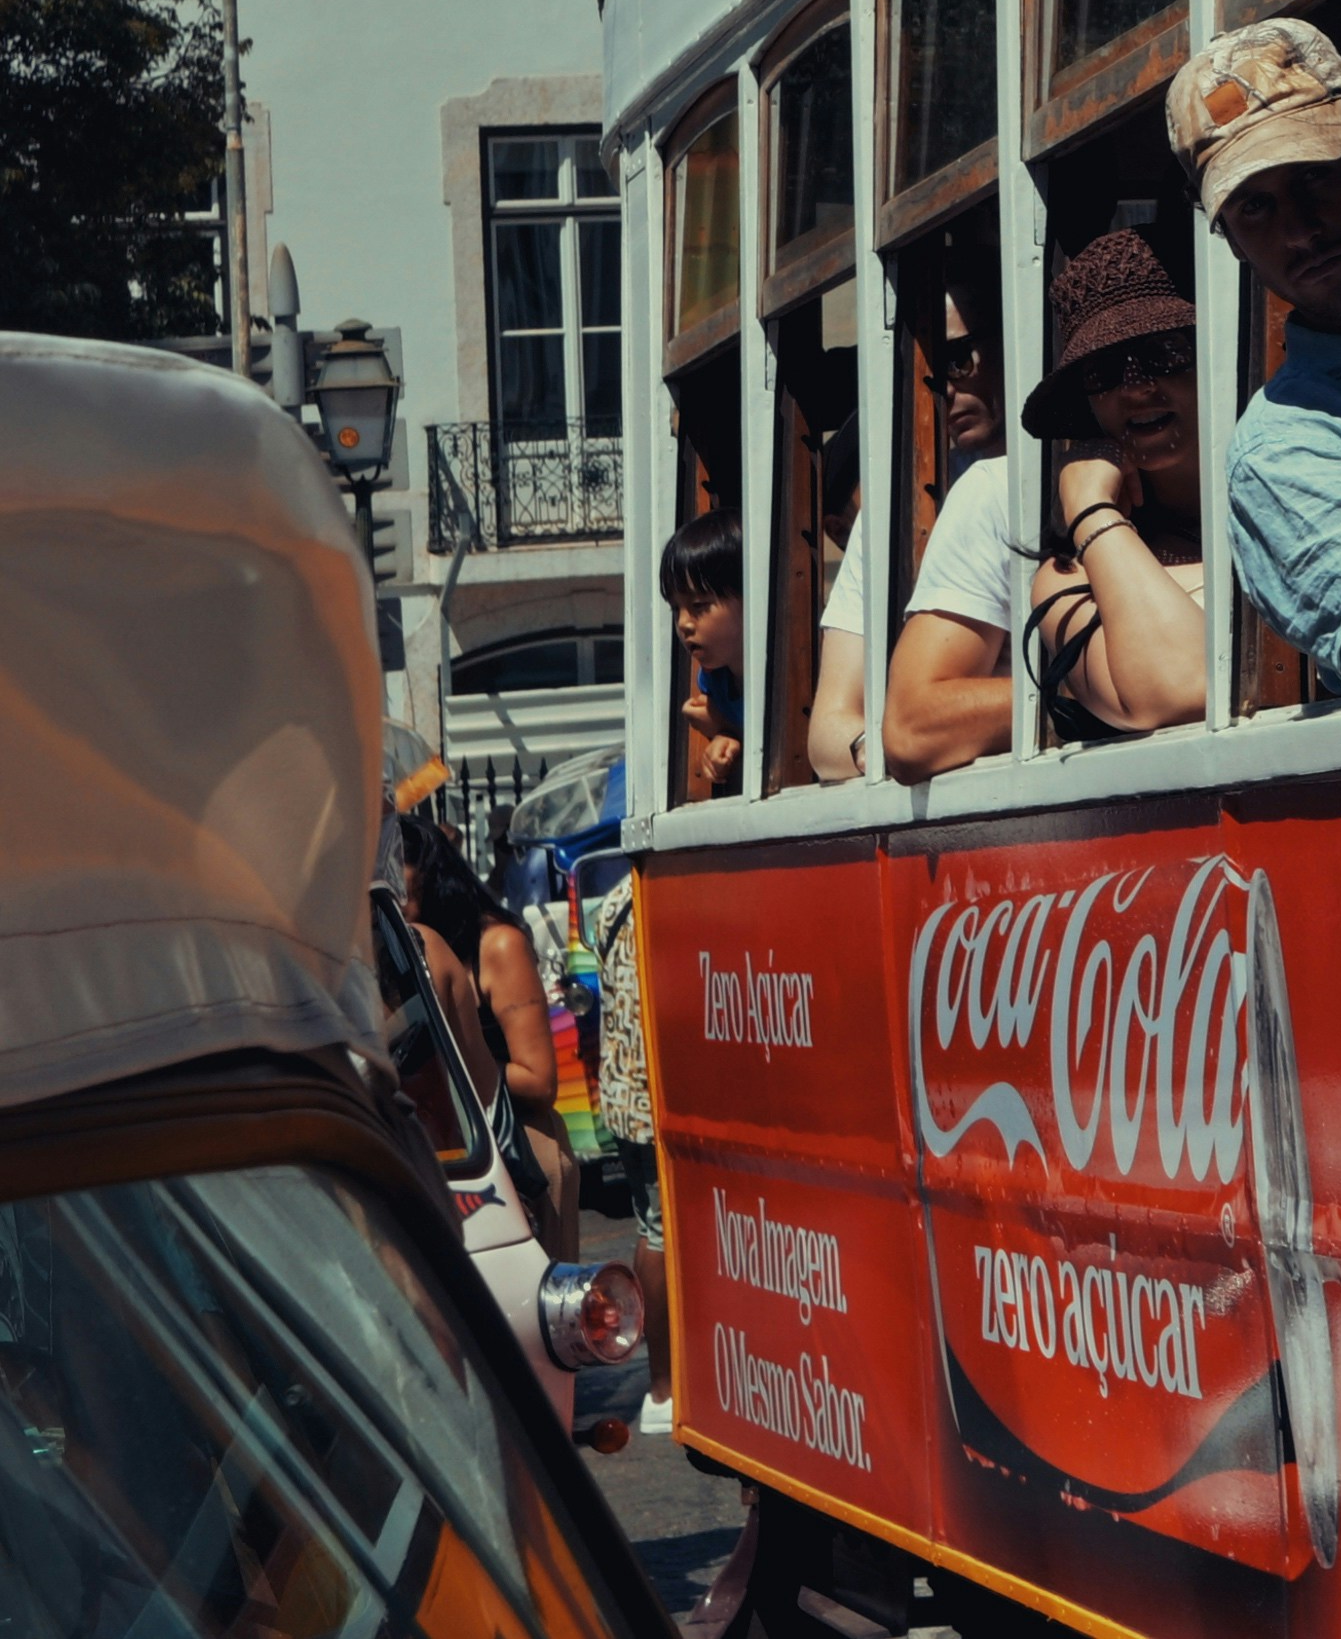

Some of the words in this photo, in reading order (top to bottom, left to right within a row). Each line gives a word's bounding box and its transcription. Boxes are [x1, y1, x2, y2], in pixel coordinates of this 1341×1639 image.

[698, 950, 744, 1044] Zero
[744, 948, 814, 1064] Açúcar
[918, 852, 1252, 1186] Coca-Cola
[713, 1186, 762, 1290] Nova
[758, 1196, 848, 1327] Imagem.
[974, 1244, 1058, 1360] zero
[1057, 1232, 1207, 1400] açúcar
[714, 1321, 731, 1413] O
[728, 1326, 801, 1443] Mesmo
[799, 1351, 872, 1473] Sabor.
